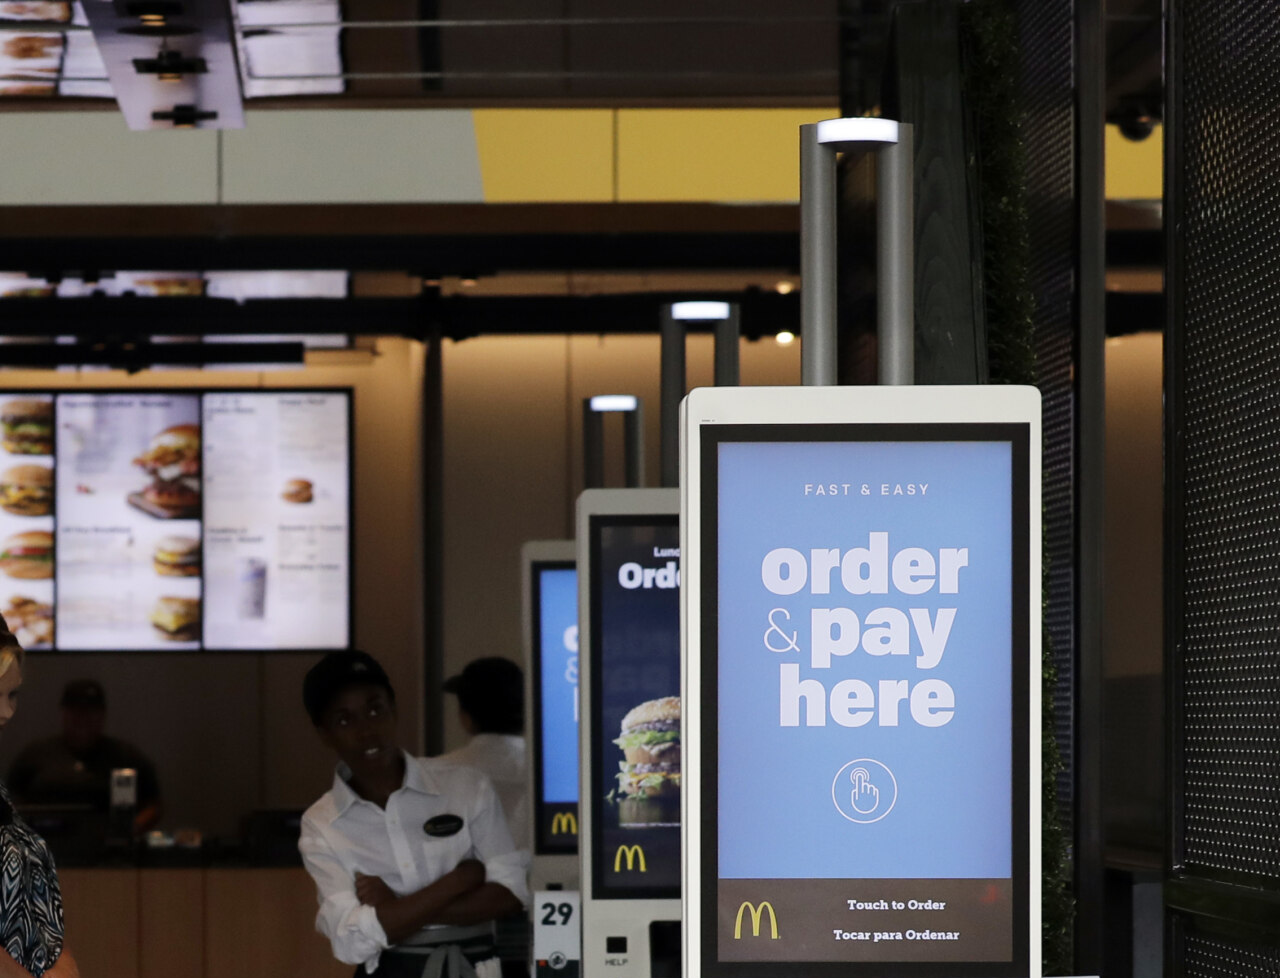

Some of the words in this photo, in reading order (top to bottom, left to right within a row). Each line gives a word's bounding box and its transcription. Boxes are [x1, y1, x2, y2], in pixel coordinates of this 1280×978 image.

[804, 484, 851, 495] FAST
[860, 484, 870, 495] &
[881, 484, 929, 495] EASY
[761, 531, 968, 595] order
[763, 608, 801, 653] &
[811, 607, 957, 669] pay
[779, 663, 955, 728] here
[847, 899, 889, 910] Touch
[891, 900, 905, 910] to
[907, 899, 946, 910] Order
[541, 902, 573, 926] 29
[833, 929, 871, 940] Tocar
[873, 931, 903, 942] para
[905, 929, 960, 940] Ordenar
[605, 958, 629, 966] HELP
